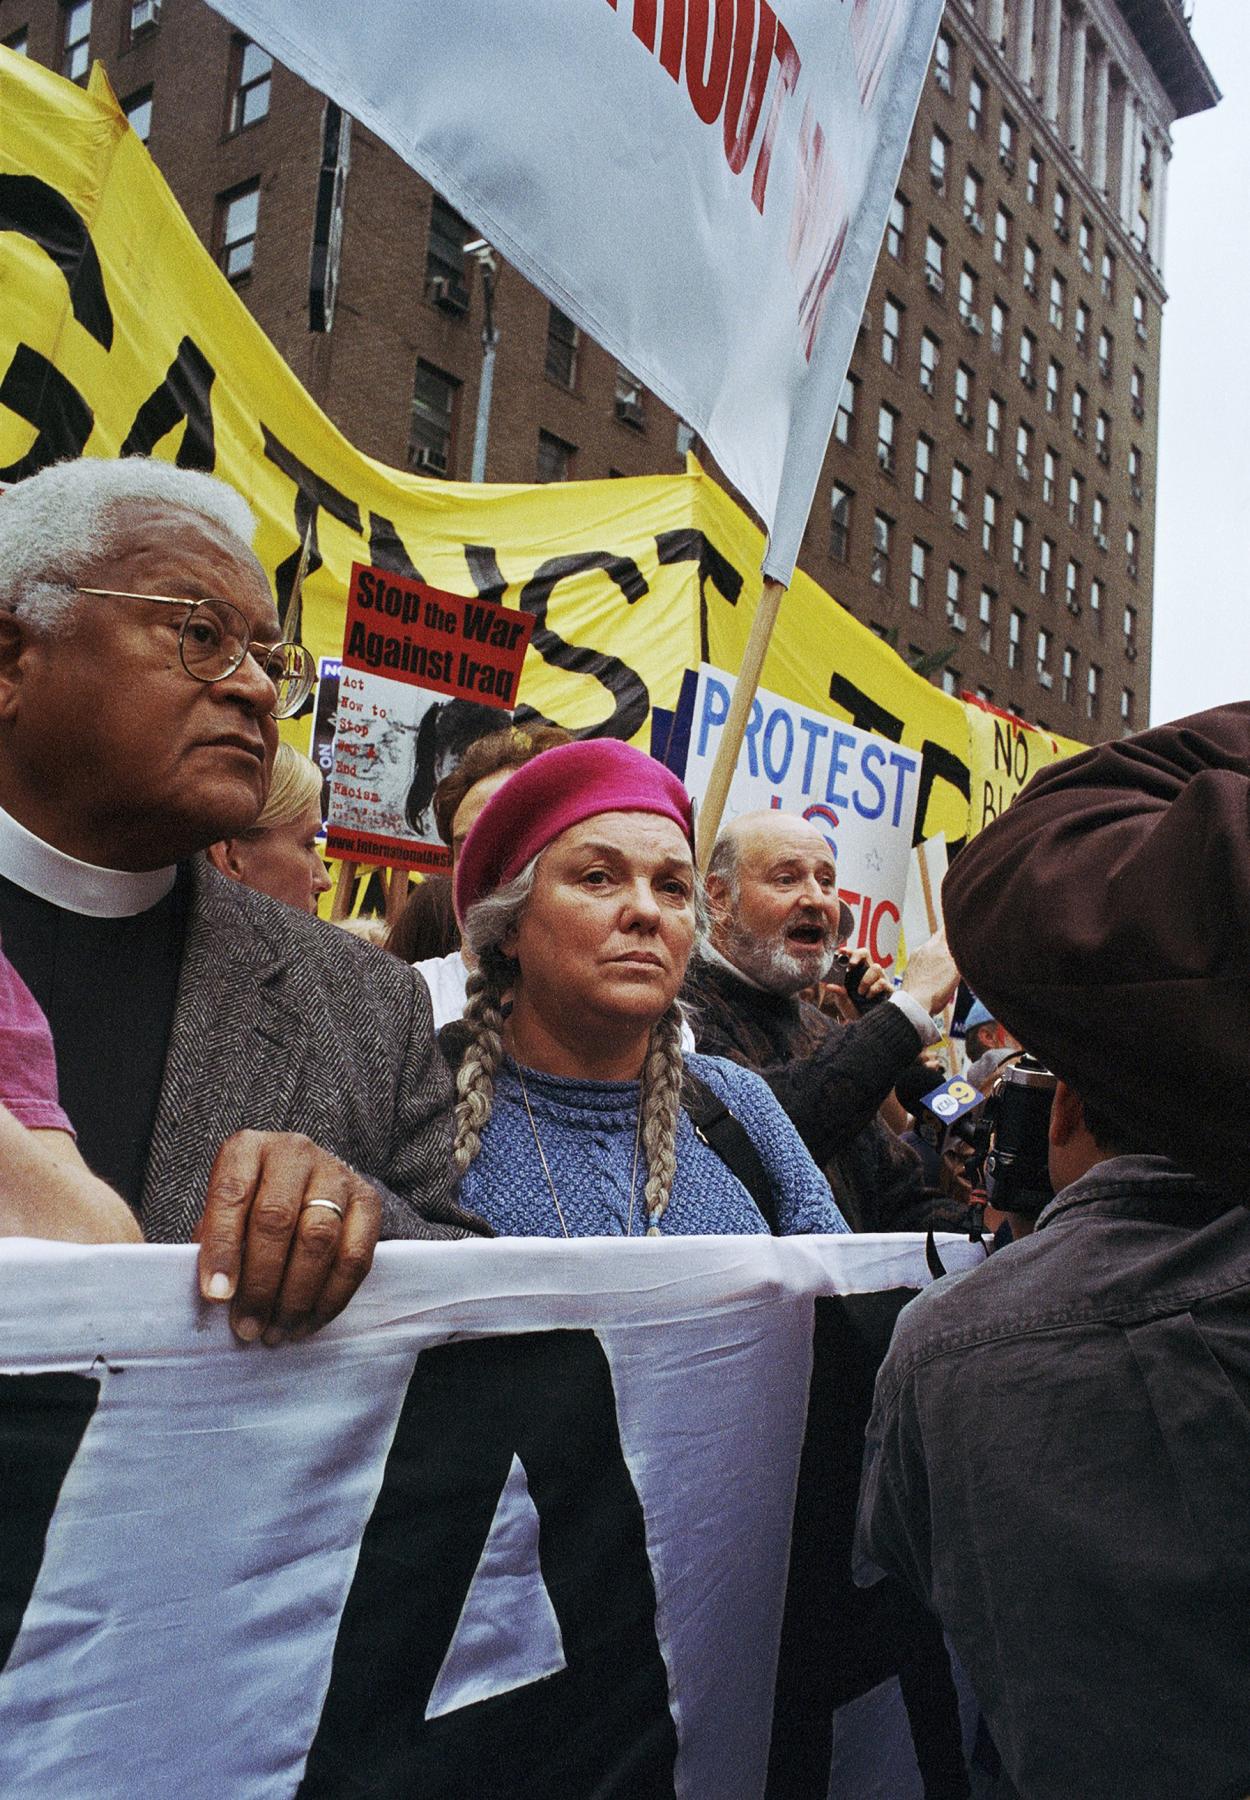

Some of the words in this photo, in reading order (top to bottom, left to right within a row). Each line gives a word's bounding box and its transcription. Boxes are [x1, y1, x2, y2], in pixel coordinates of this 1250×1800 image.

[356, 570, 421, 625] Stop
[423, 601, 458, 634] the
[461, 603, 526, 651] War
[343, 675, 364, 690] Act
[347, 620, 454, 684] Against
[457, 652, 515, 703] Iraq
[339, 717, 369, 737] Stop
[372, 704, 387, 719] to
[696, 677, 917, 828] PROTEST
[994, 719, 1029, 786] NO
[333, 782, 381, 803] Racism
